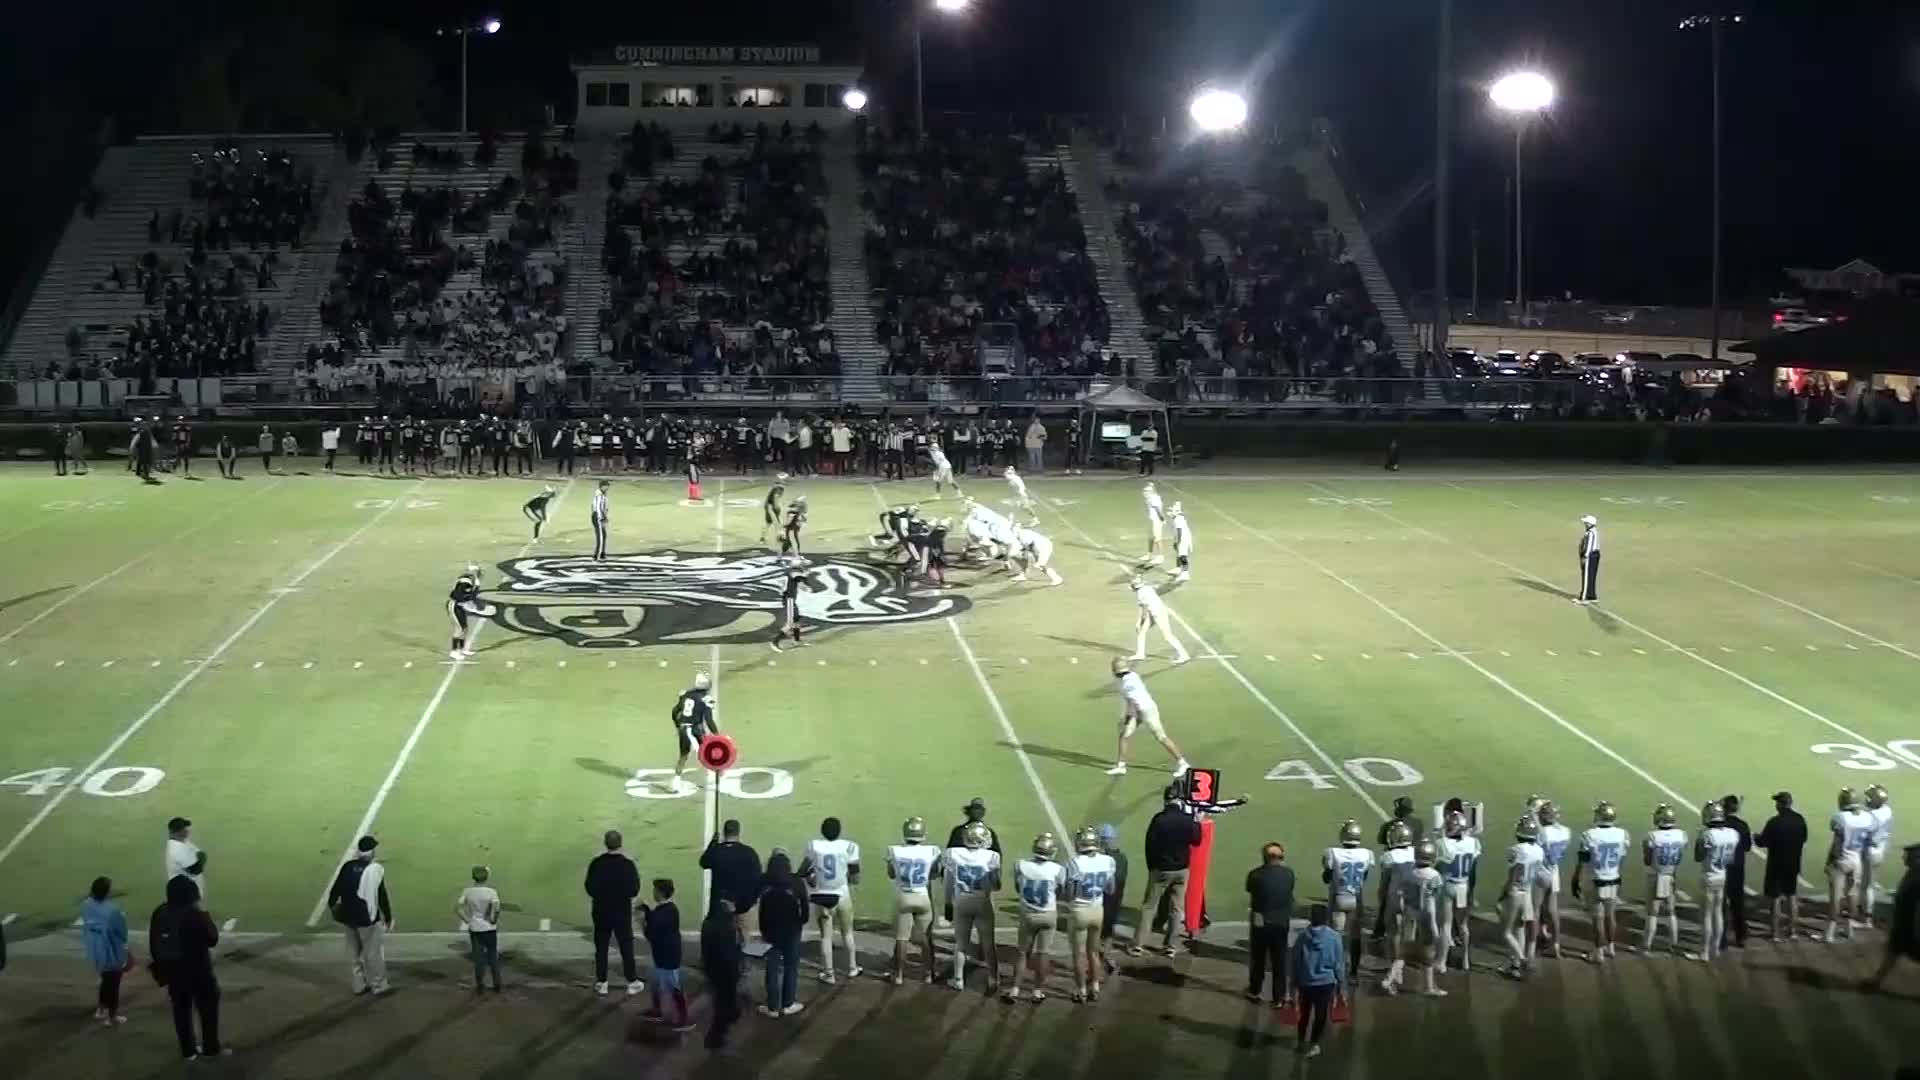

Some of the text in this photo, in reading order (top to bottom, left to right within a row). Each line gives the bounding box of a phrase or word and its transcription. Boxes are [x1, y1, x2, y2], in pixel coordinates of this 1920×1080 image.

[0, 766, 166, 797] 40
[624, 767, 794, 799] 50
[1191, 771, 1212, 801] 3
[1263, 757, 1425, 789] 40
[823, 853, 837, 881] 9
